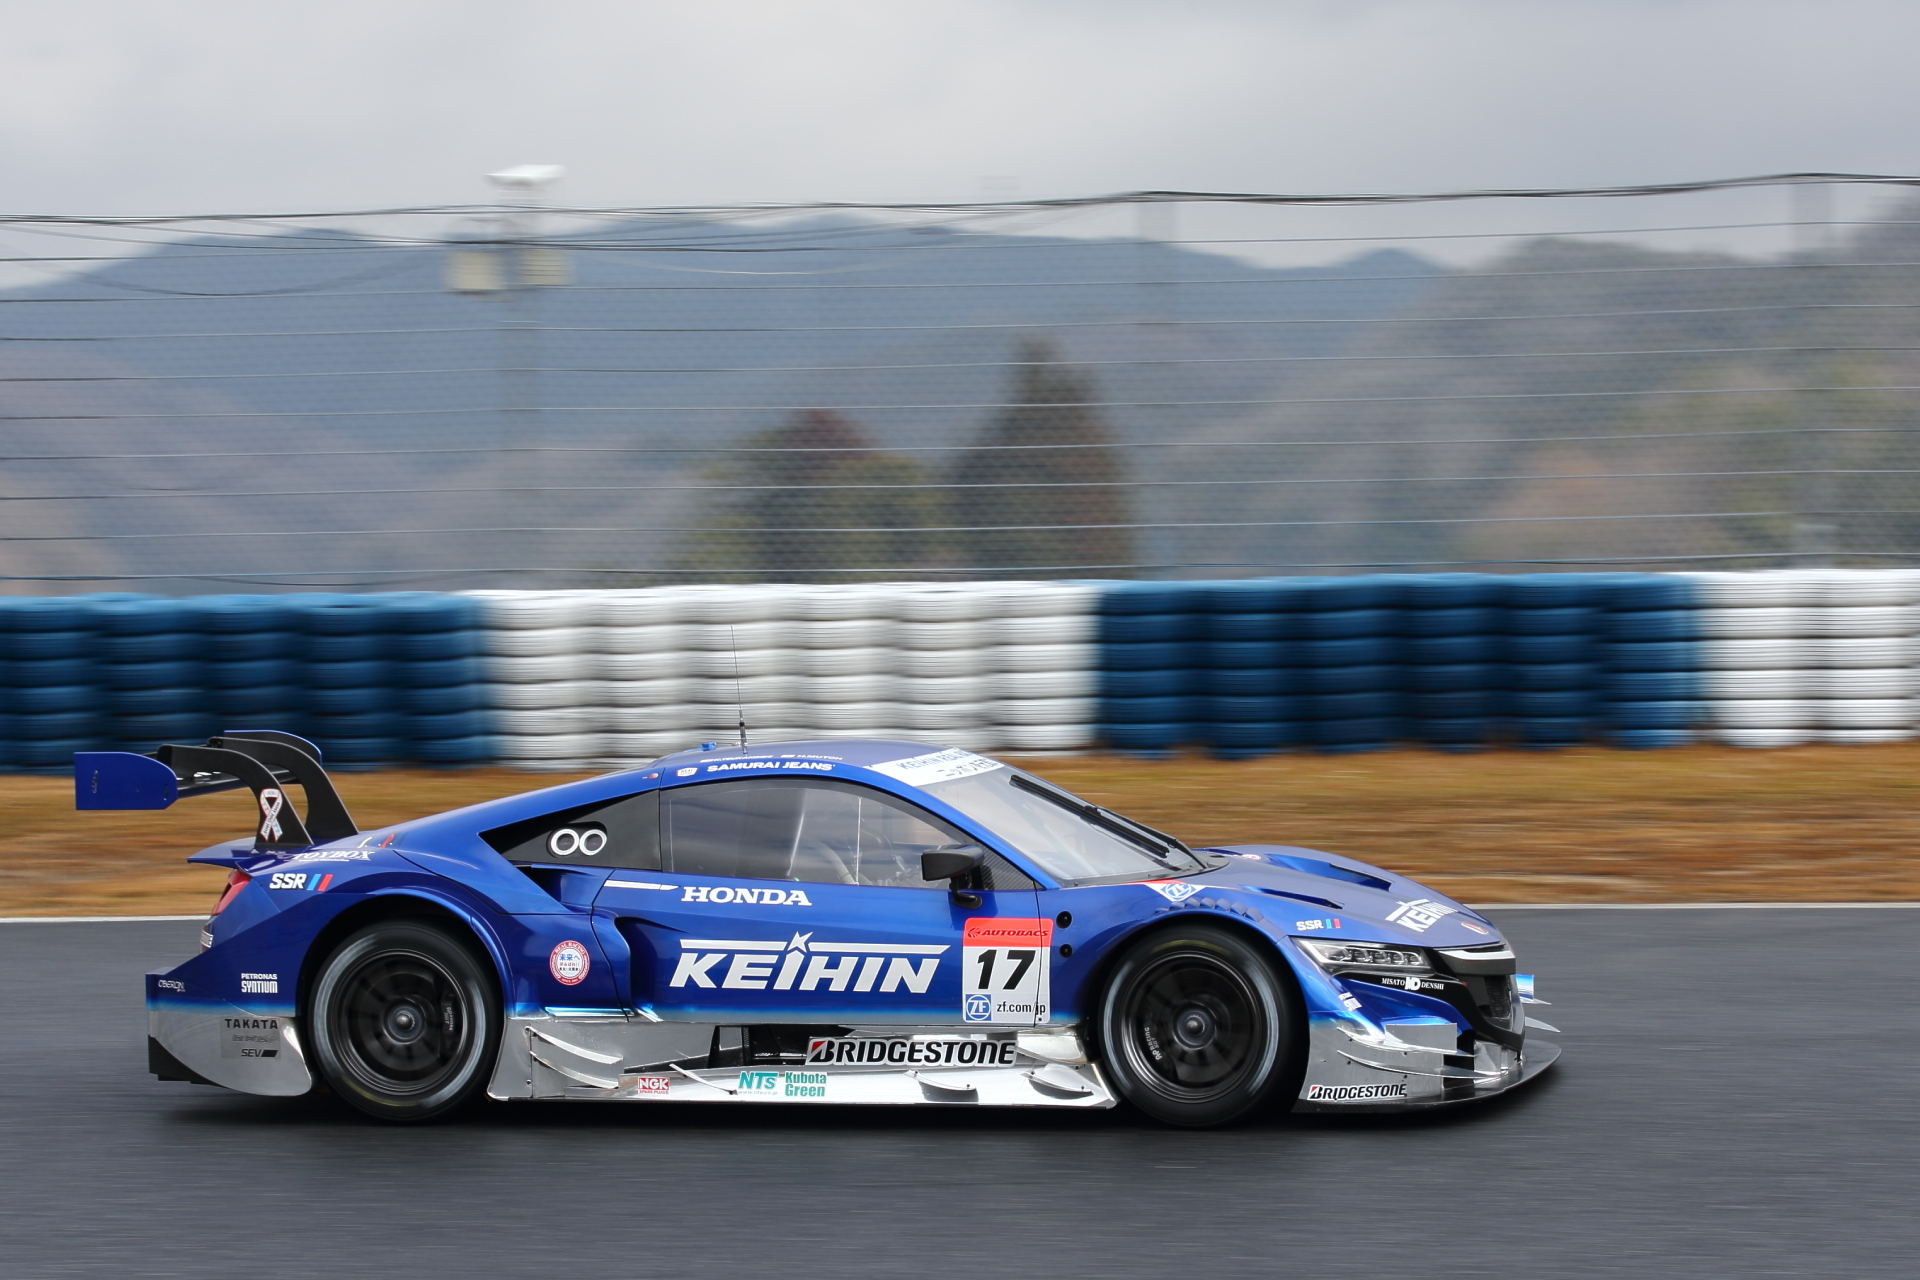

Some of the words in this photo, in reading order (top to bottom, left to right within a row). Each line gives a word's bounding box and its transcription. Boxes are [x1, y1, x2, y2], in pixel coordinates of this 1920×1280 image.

[706, 762, 781, 772] SAMURAI
[782, 761, 833, 771] JEANS
[269, 873, 307, 889] SSR
[681, 886, 812, 906] HONDA
[1296, 919, 1325, 931] SSR
[981, 929, 1050, 937] AUTOBACS
[669, 950, 941, 994] KEIHIN
[977, 949, 1036, 990] 17
[1381, 977, 1405, 986] MISATO
[1421, 981, 1445, 990] DENSHI
[968, 1000, 988, 1016] ZF
[996, 1001, 1046, 1015] zf.com/jp
[224, 1018, 279, 1029] TAKATA
[241, 1049, 262, 1058] SEV
[808, 1040, 1016, 1064] BRIDGESTONE
[639, 1078, 669, 1090] NGK
[785, 1072, 827, 1084] Kubota
[785, 1084, 825, 1097] Green
[1309, 1083, 1407, 1100] BRIDGESTONE
